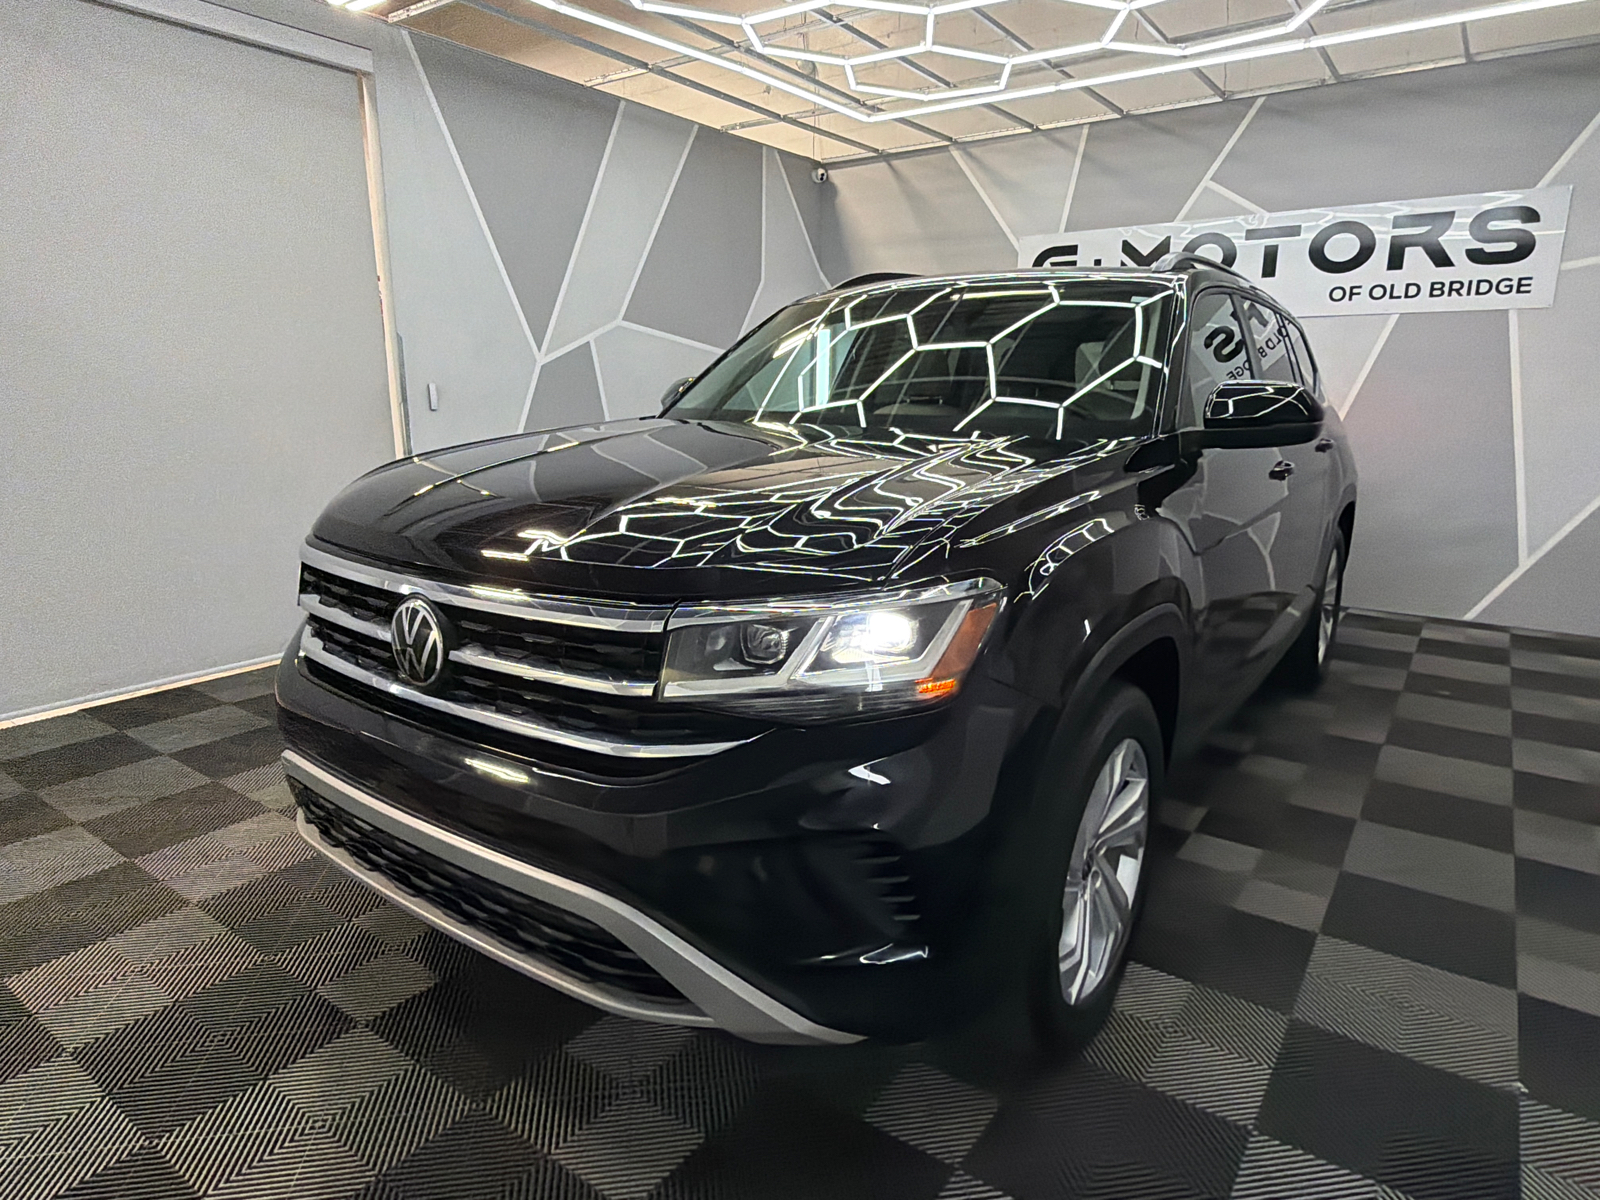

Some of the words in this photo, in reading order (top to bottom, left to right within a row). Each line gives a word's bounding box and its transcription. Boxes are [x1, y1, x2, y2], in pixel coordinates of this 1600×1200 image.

[1329, 285, 1362, 302] OF
[1368, 282, 1421, 300] OLD
[1428, 277, 1533, 298] BRIDGE
[392, 601, 442, 685] VW
